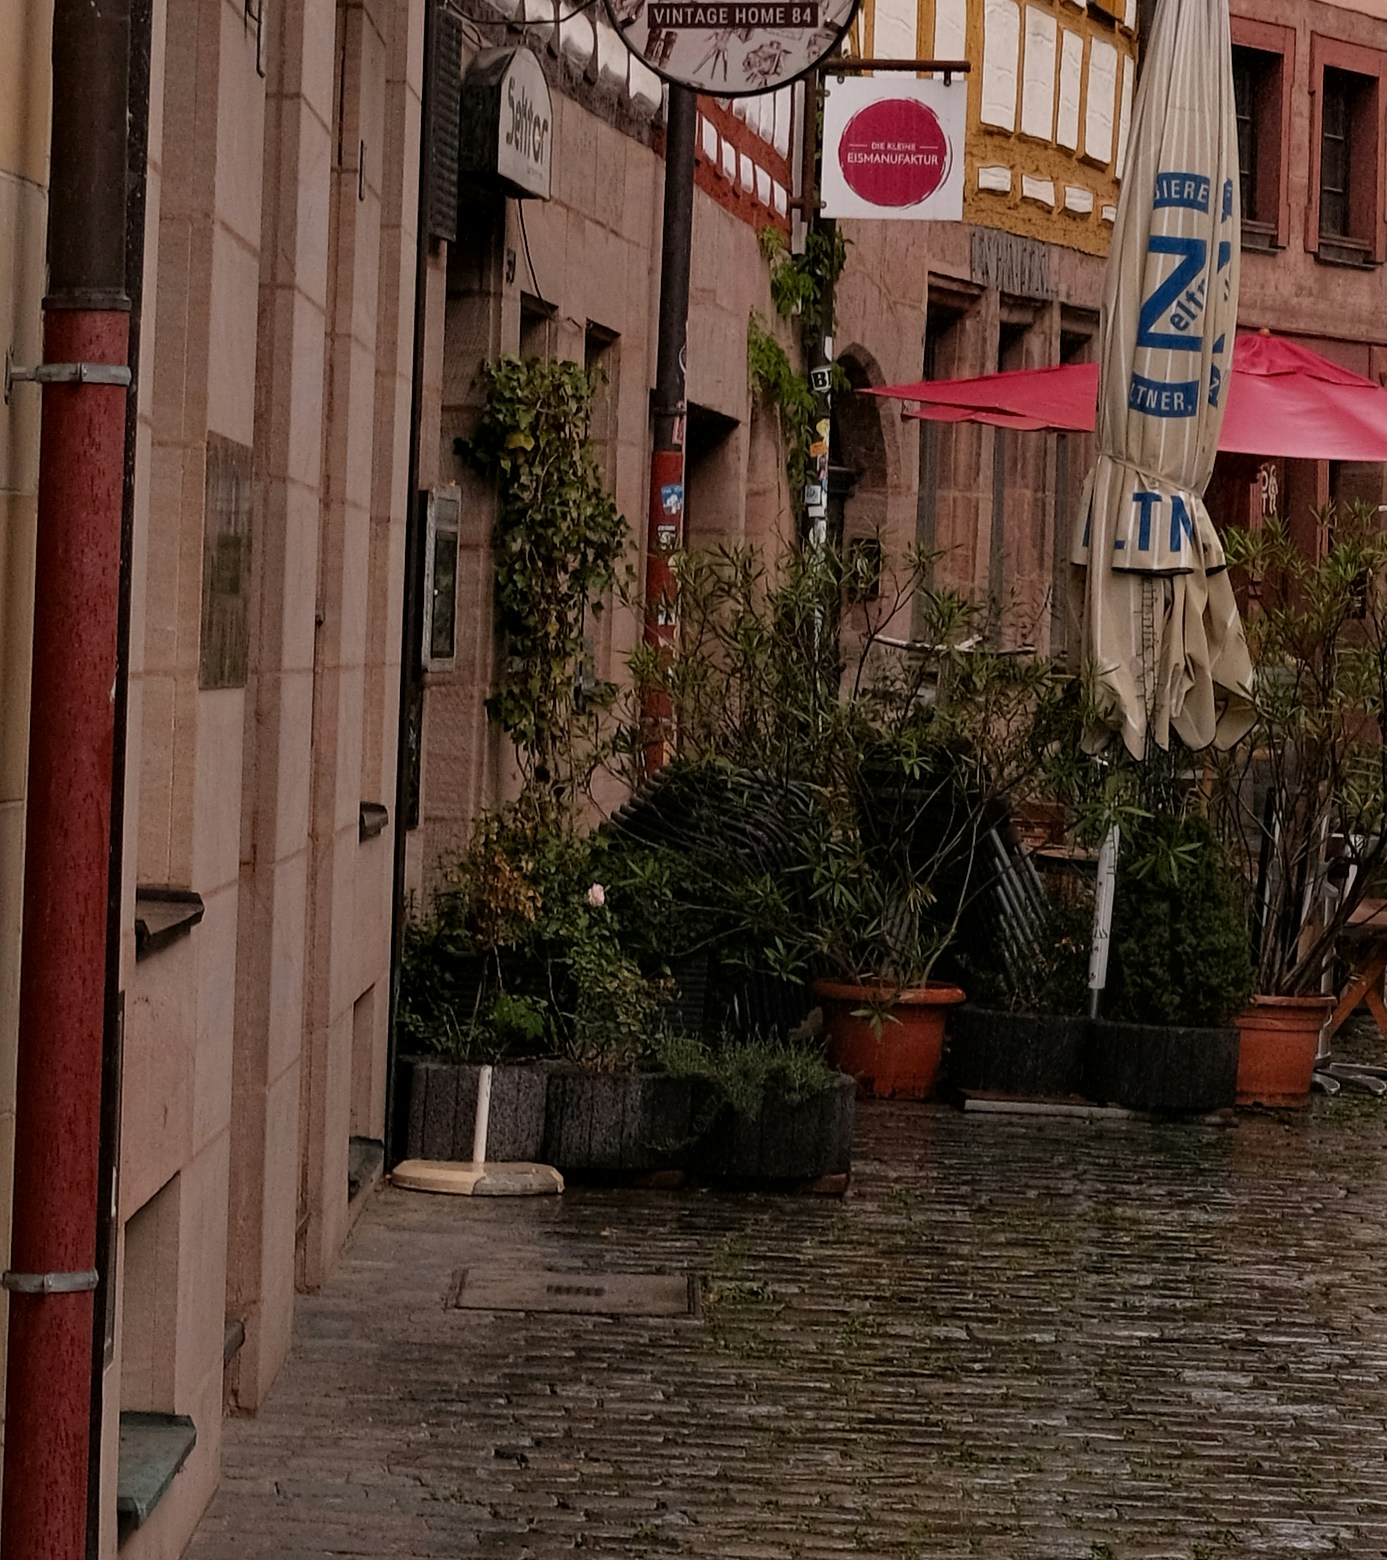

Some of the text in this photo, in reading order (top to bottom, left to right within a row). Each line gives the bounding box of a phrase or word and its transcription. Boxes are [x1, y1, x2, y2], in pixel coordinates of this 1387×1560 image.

[654, 7, 812, 24] VINTAGE HOME 84
[847, 152, 939, 165] EISMANUFAKTUR
